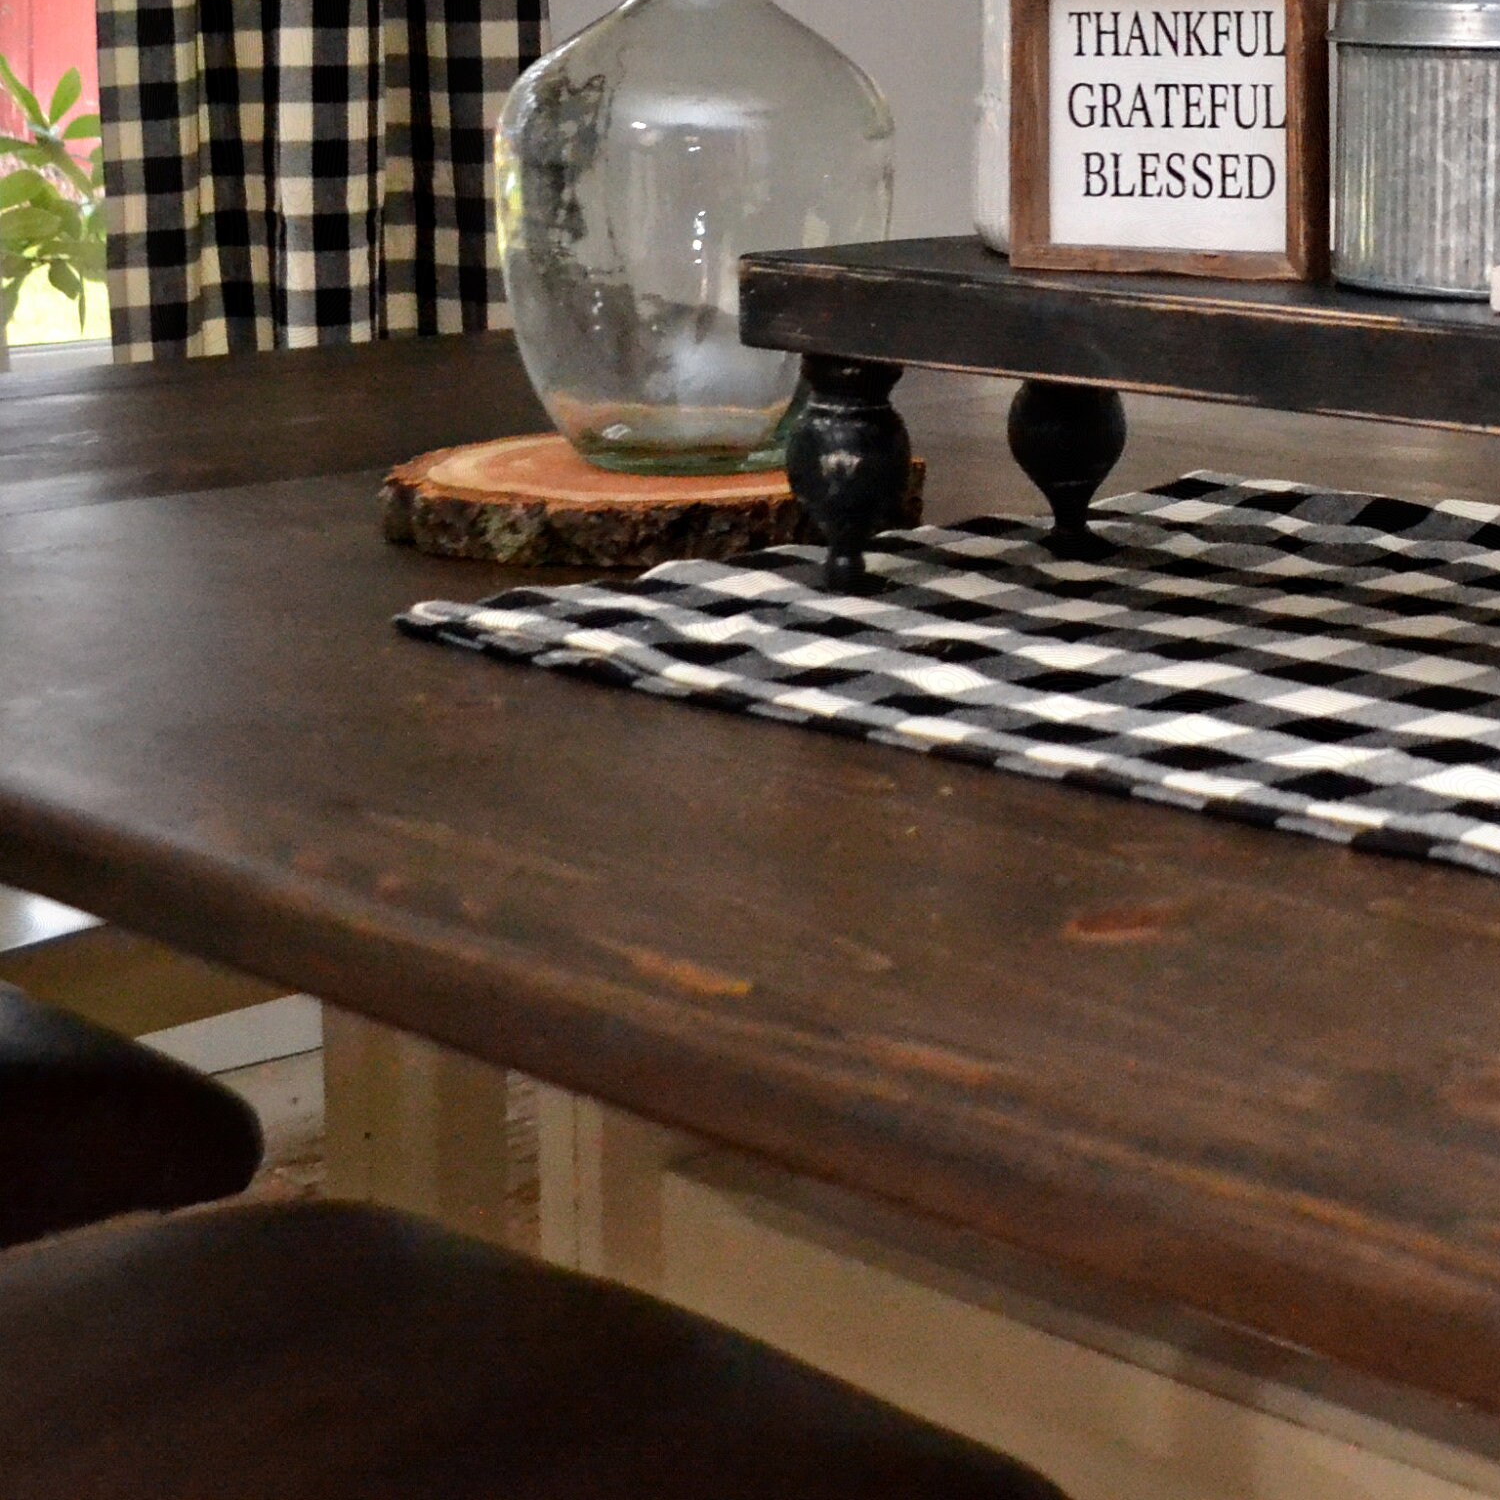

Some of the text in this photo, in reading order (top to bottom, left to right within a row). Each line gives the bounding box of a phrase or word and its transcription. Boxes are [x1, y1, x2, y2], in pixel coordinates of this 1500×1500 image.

[1068, 10, 1286, 58] THANKFUL
[1068, 82, 1286, 130] GRATEFUL
[1082, 152, 1276, 200] BLESSED
